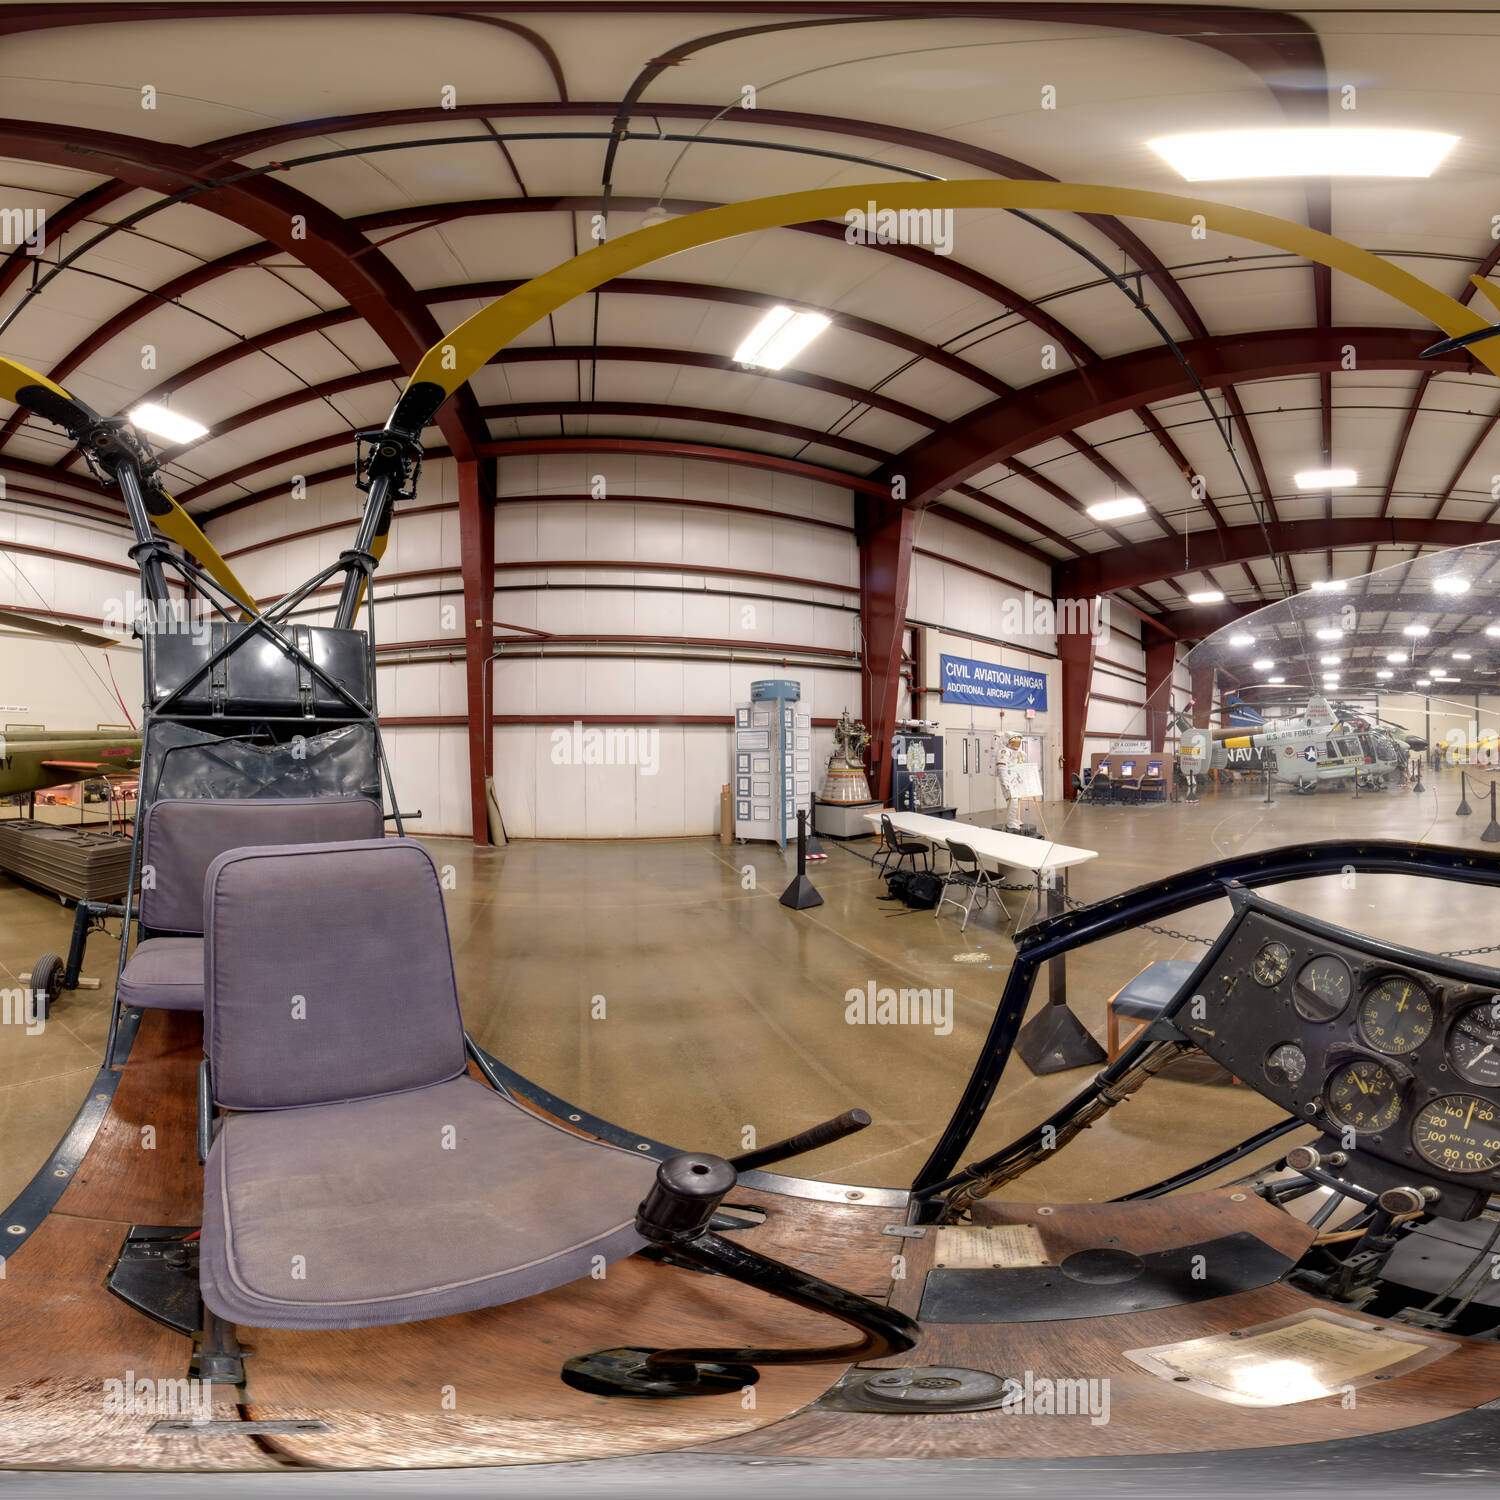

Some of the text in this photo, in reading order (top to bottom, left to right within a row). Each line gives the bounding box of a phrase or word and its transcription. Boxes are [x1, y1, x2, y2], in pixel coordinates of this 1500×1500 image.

[946, 663, 1043, 689] CIVIL AVIATION HANGAR
[947, 682, 1014, 700] ADDITIONAL AIRCRAFT
[1294, 729, 1314, 737] FORCE
[1227, 747, 1264, 761] NAVY
[1416, 1005, 1426, 1013] 40
[1477, 1014, 1484, 1022] 15
[1414, 1026, 1424, 1034] 50
[1394, 1037, 1404, 1045] 60
[1361, 1069, 1367, 1077] 9
[1376, 1070, 1382, 1078] 0
[1348, 1076, 1354, 1084] 8
[1445, 1106, 1463, 1118] 140
[1478, 1110, 1493, 1120] 20
[1429, 1116, 1447, 1127] 120
[1428, 1131, 1446, 1143] 100
[1483, 1139, 1500, 1150] 40
[1444, 1149, 1460, 1159] 80
[1466, 1151, 1483, 1161] 60
